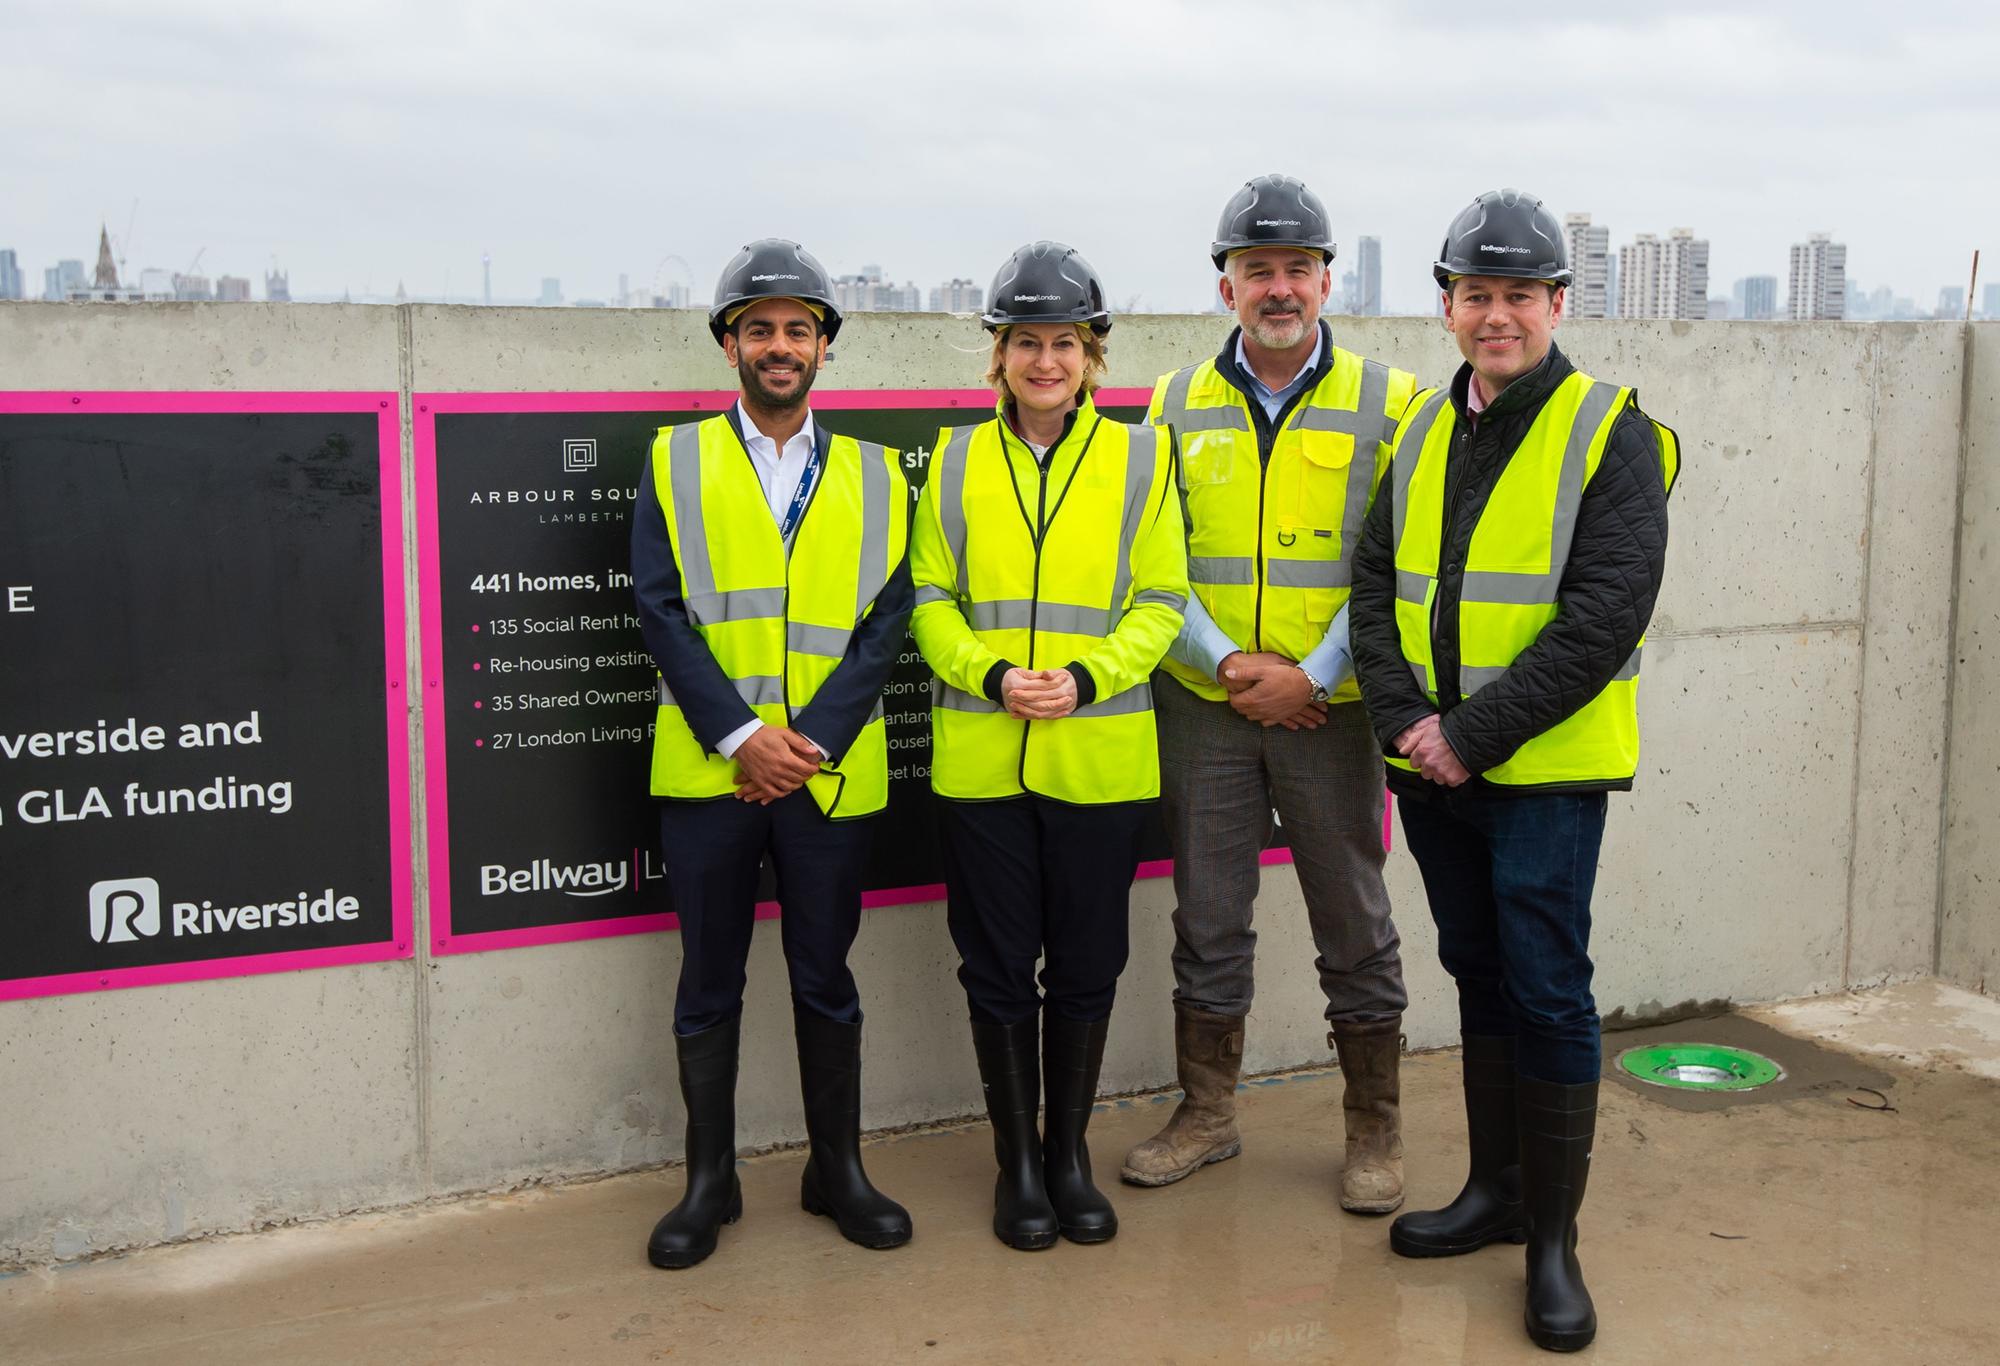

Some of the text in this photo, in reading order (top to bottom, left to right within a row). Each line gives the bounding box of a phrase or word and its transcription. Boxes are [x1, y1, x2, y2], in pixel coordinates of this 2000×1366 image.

[470, 489, 574, 504] ARBOUR
[539, 512, 623, 524] LAMBETH
[470, 573, 510, 594] 441
[518, 572, 601, 592] homes,
[7, 585, 35, 613] E
[489, 619, 518, 635] 135
[523, 615, 575, 634] Social
[580, 615, 619, 631] Rent
[490, 654, 590, 673] Re-housing
[492, 695, 513, 712] 35
[518, 691, 580, 710] Shared
[178, 710, 262, 749] and
[493, 733, 513, 750] 27
[518, 729, 586, 748] London
[591, 725, 642, 743] Living
[17, 786, 113, 824] GLA
[123, 775, 292, 817] funding
[480, 858, 627, 897] Bellway
[172, 888, 360, 937] Riverside
